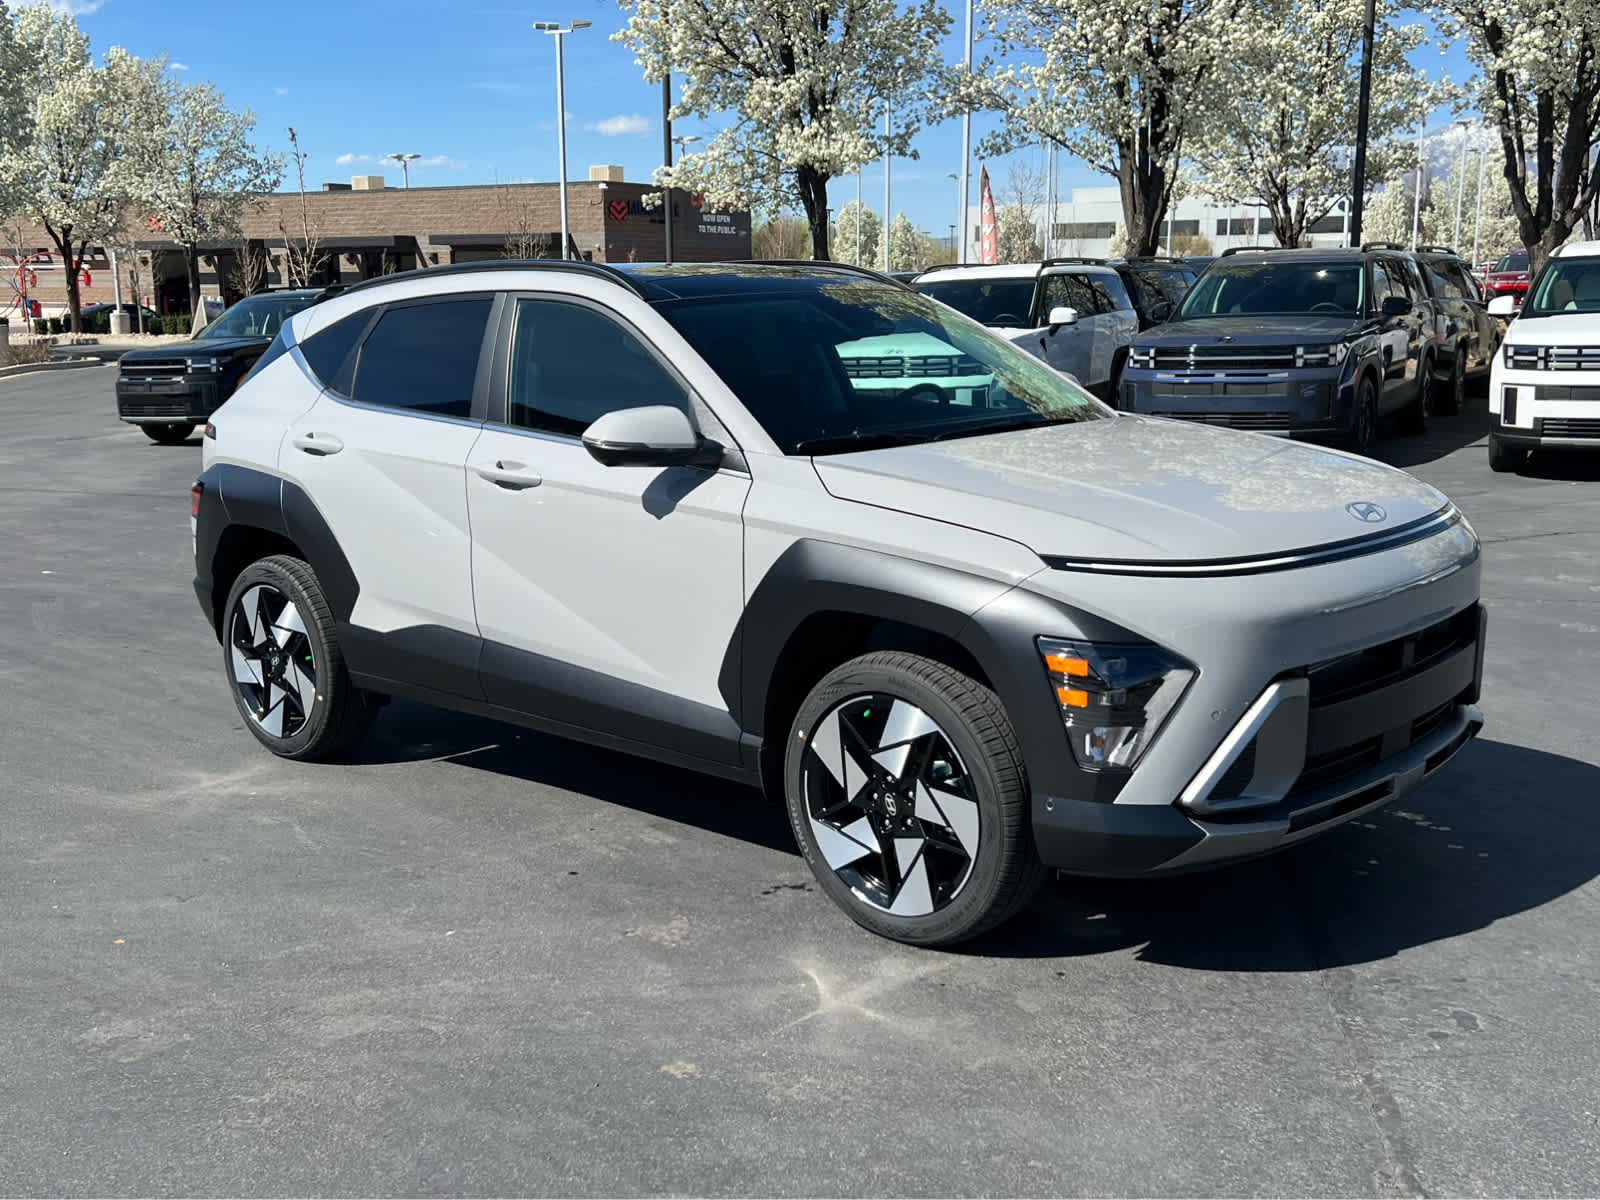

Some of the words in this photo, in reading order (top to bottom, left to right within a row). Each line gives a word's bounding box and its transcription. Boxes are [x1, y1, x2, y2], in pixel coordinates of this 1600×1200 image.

[702, 214, 716, 222] NOW
[716, 215, 731, 223] OPEN
[698, 225, 706, 233] TO
[706, 225, 717, 233] THE
[717, 226, 736, 234] PUBLIC
